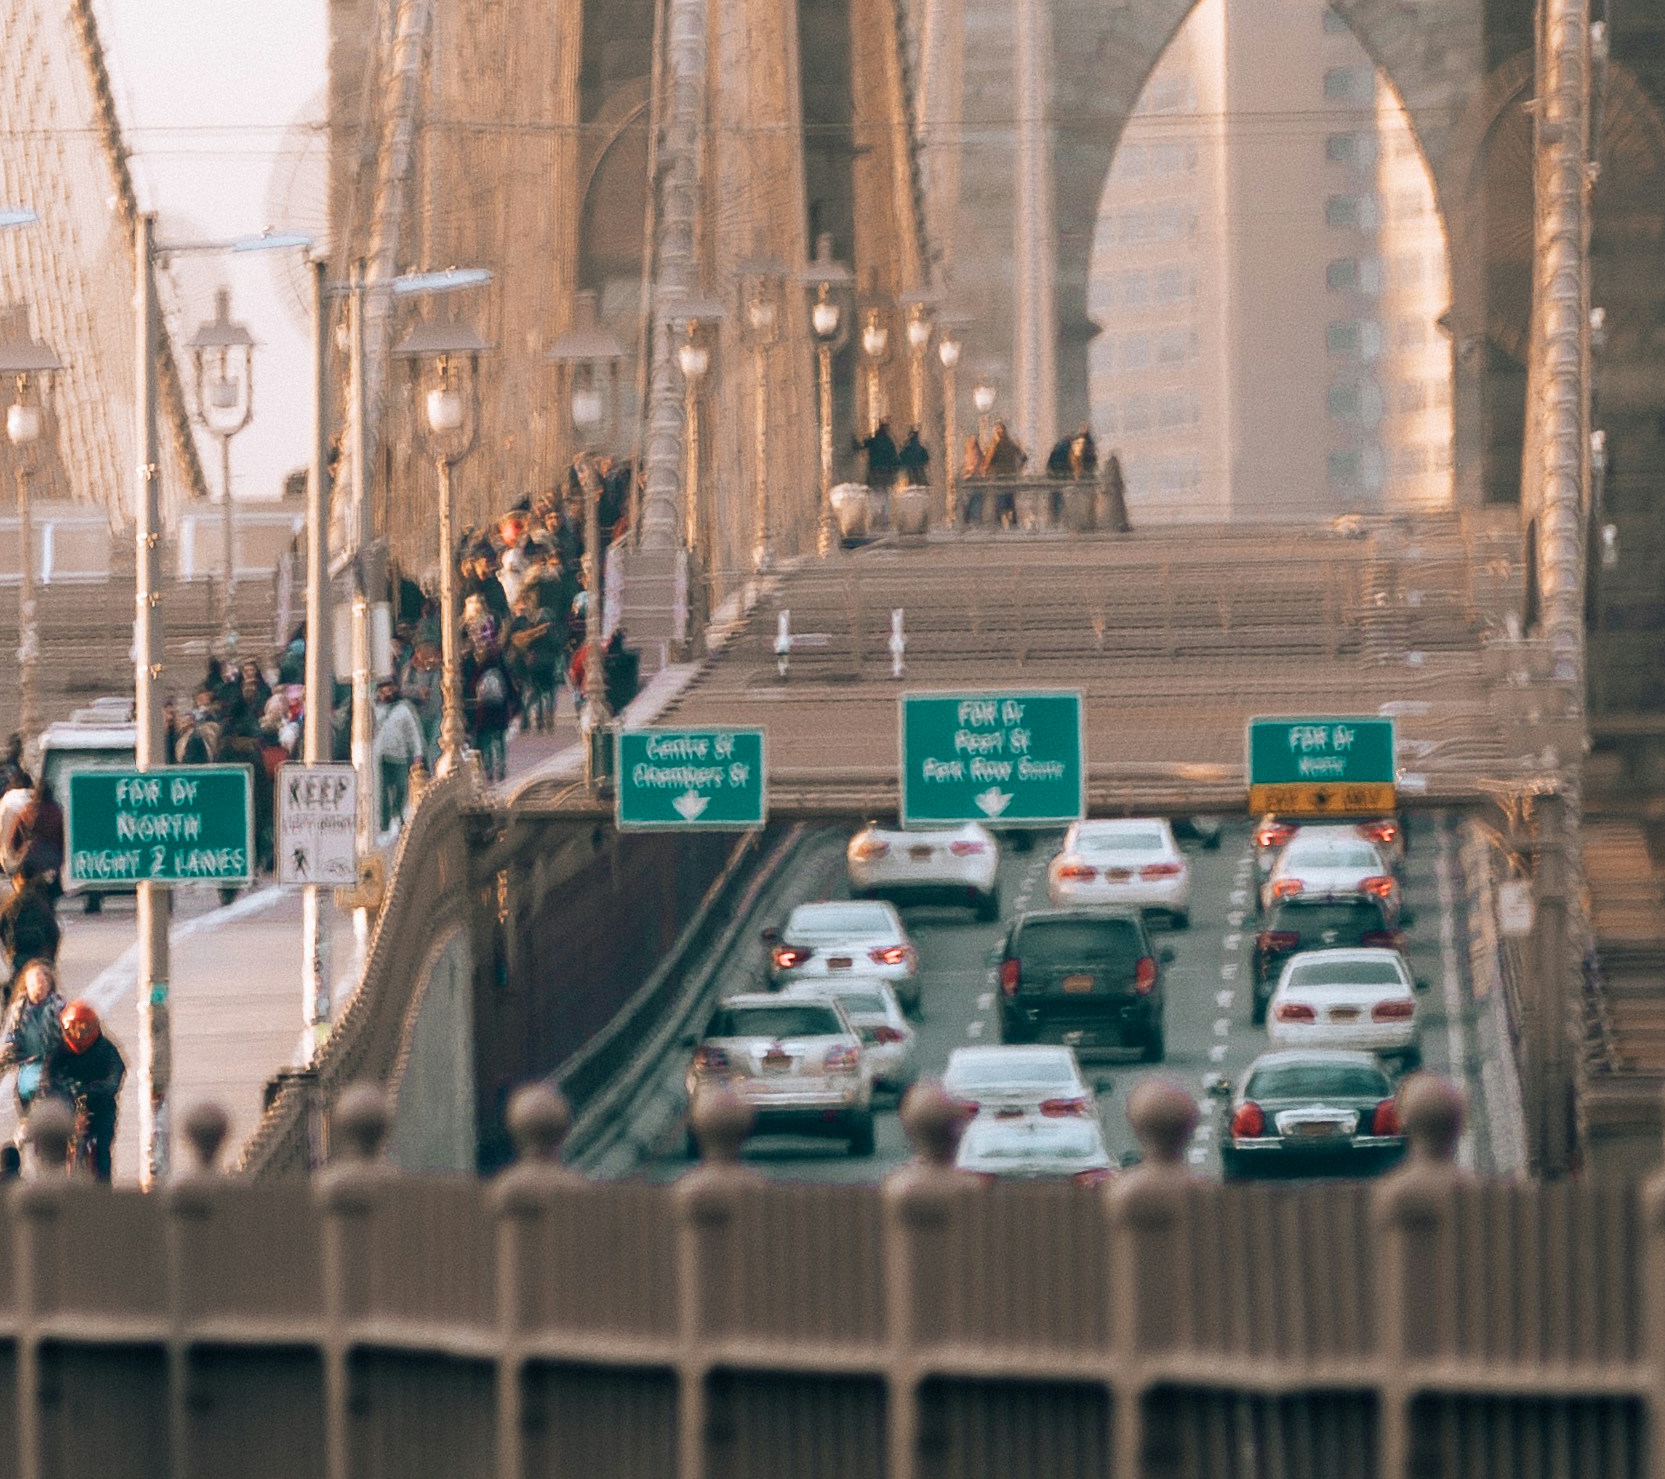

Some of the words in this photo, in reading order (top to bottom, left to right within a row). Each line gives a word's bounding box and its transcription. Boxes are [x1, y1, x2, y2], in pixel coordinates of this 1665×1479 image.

[958, 701, 998, 727] FDR
[1289, 726, 1329, 753] FDR
[633, 763, 724, 788] Chambers
[970, 757, 1013, 782] Row
[116, 778, 162, 807] FDR
[170, 777, 200, 806] Dr
[288, 775, 349, 811] KEEP
[74, 849, 143, 878] RIGHT
[150, 845, 167, 878] 2
[174, 847, 245, 877] LANES
